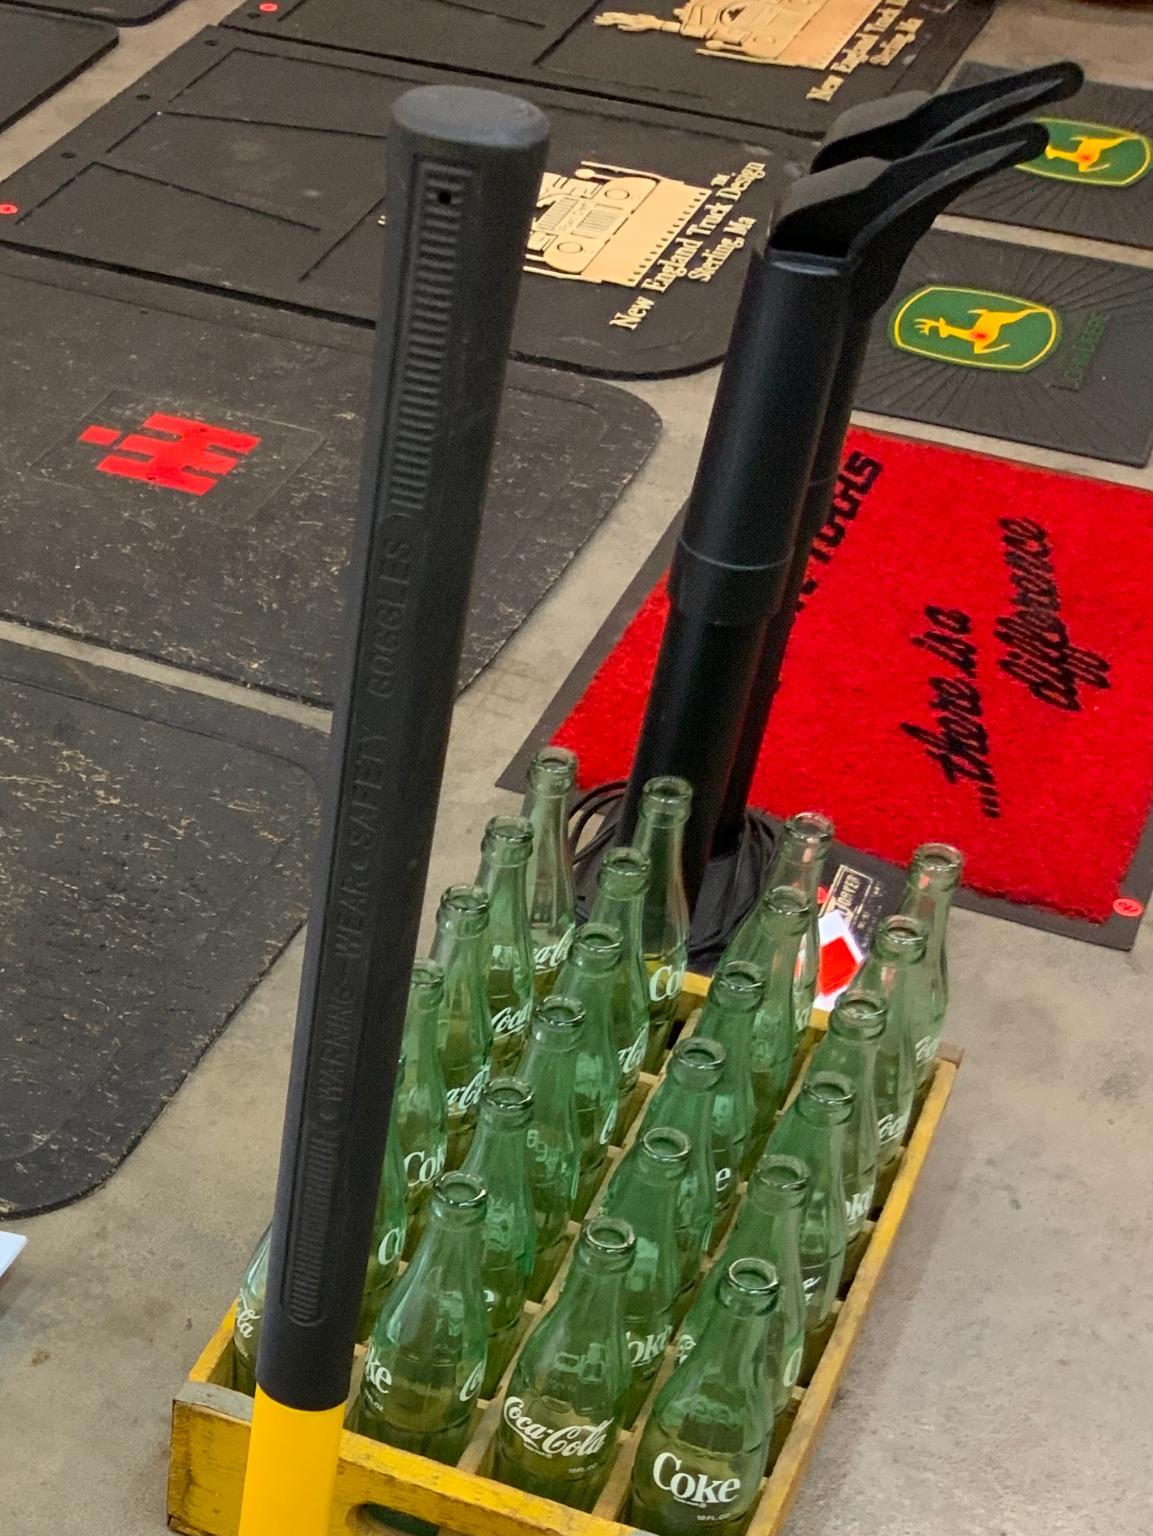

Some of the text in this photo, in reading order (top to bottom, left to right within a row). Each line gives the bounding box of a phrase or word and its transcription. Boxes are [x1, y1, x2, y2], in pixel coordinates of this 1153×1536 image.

[609, 296, 655, 330] New
[641, 237, 704, 293] England
[686, 202, 734, 236] Truck
[716, 162, 766, 201] Design
[995, 516, 1109, 711] difference
[504, 1396, 613, 1459] Coca-Cola
[653, 1452, 741, 1504] Coke
